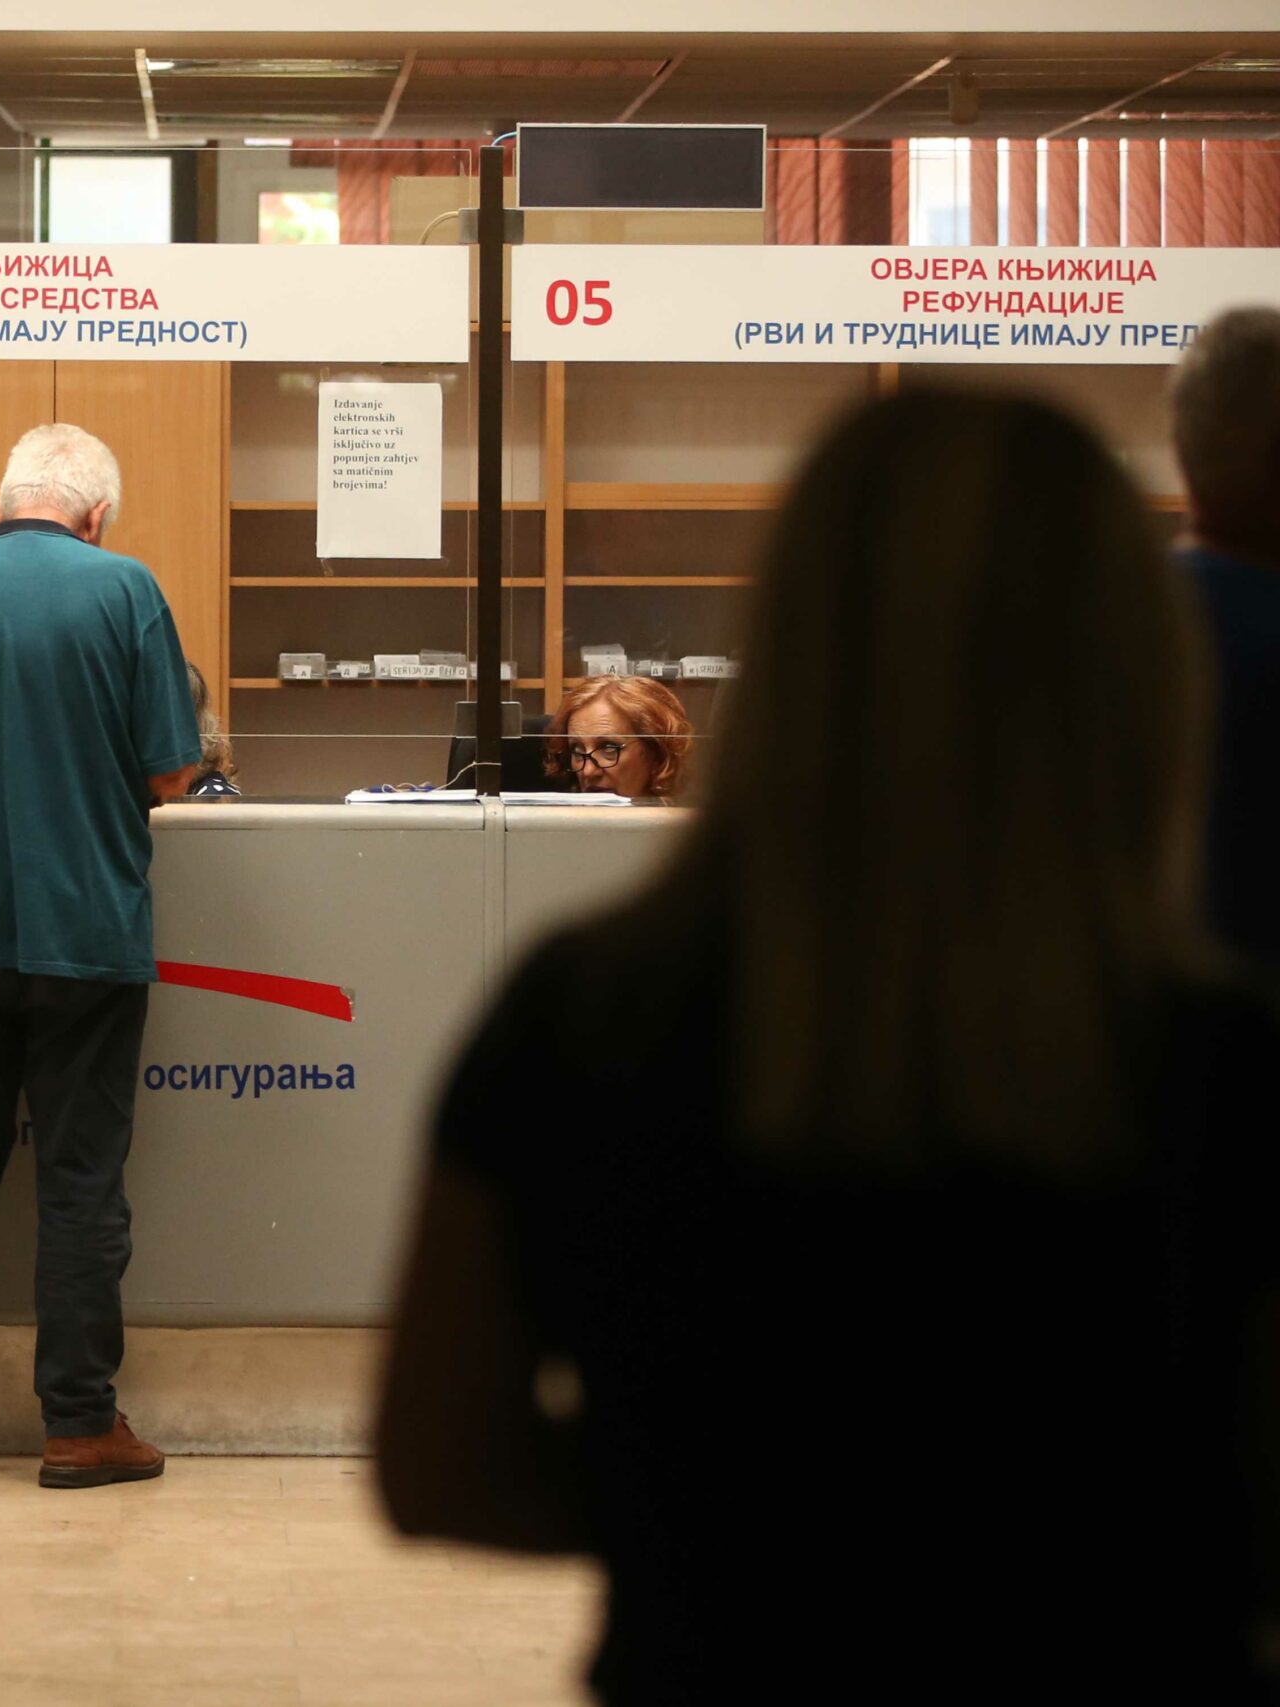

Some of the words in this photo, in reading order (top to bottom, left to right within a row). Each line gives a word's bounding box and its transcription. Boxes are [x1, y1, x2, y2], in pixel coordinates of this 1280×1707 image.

[871, 258, 987, 280] ОВЈЕРА
[999, 259, 1156, 285] КЊИЖИЦА
[1, 287, 158, 312] СРЕДСТВА
[546, 280, 612, 326] 05
[904, 291, 1124, 318] РЕФУНДАЦИЈЕ
[78, 320, 248, 348] ПРЕДНОСТ)
[735, 323, 803, 350] (РВИ
[816, 323, 832, 344] И
[844, 323, 999, 349] ТРУДНИЦЕ
[1011, 324, 1110, 346] ИМАЈУ
[1121, 324, 1200, 350] ПРЕД
[334, 400, 383, 411] Izdavanje
[333, 413, 395, 422] elektronskih
[333, 427, 369, 435] kartica
[384, 427, 403, 436] vrši
[333, 440, 381, 451] isključivo
[333, 454, 380, 464] popunjen
[383, 454, 419, 465] zahtjev
[346, 467, 393, 476] matičnim
[333, 480, 387, 491] brojevima!
[143, 1063, 355, 1100] осигурања
